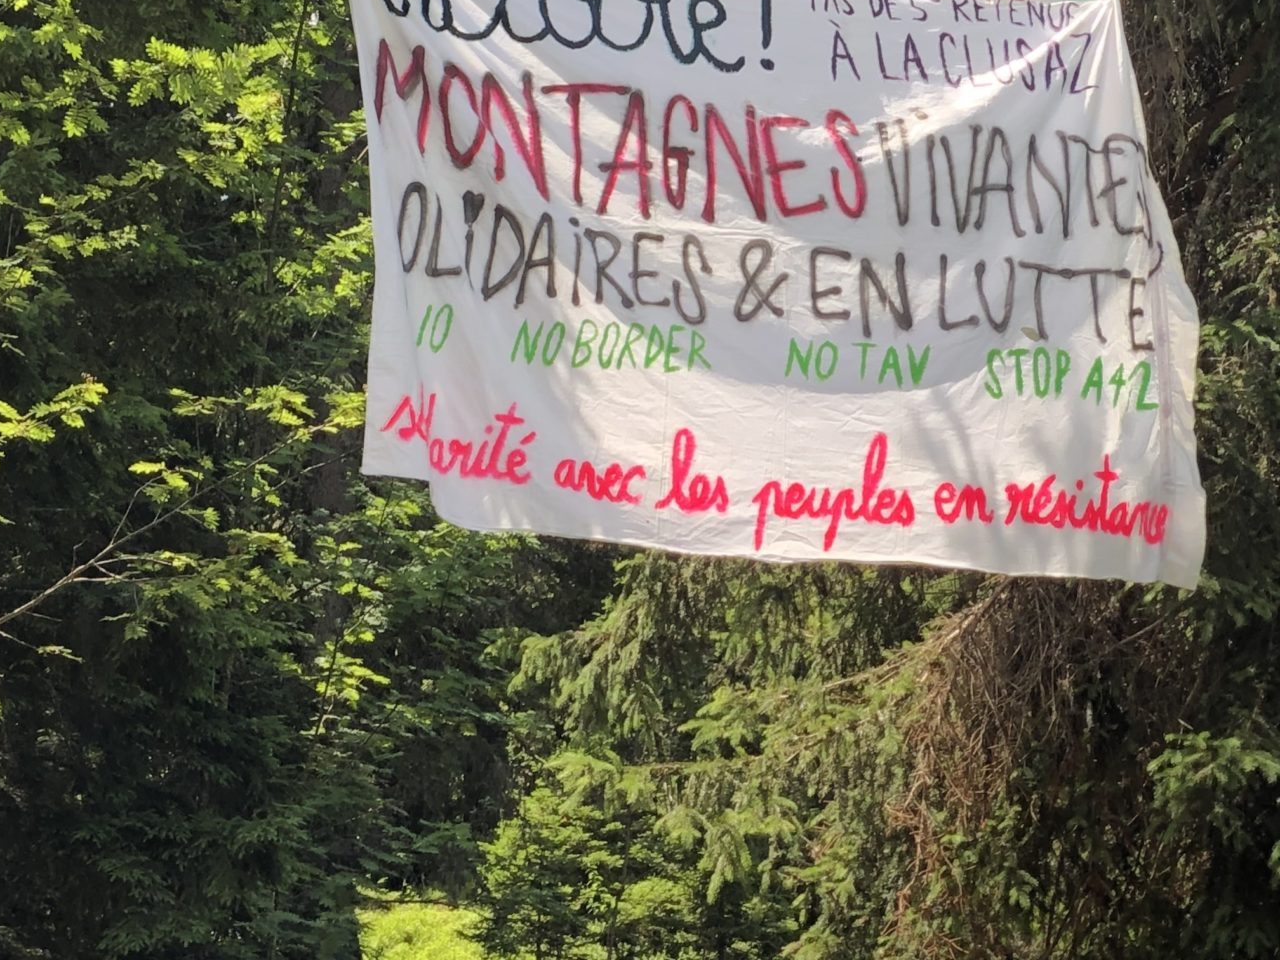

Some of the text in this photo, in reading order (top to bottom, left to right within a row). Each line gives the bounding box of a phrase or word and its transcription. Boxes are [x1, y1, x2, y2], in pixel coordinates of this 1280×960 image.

[829, 19, 1100, 95] À LA CLUSAZ
[373, 38, 868, 224] MONTAGNES
[733, 238, 791, 322] &
[810, 246, 913, 338] EN
[938, 252, 1154, 353] LUTTE
[508, 319, 568, 368] NO
[569, 318, 712, 374] BORDER
[783, 337, 839, 383] NO
[853, 342, 933, 389] TAV
[983, 346, 1072, 401] STOP
[552, 456, 648, 506] avec
[654, 426, 731, 516] les
[752, 431, 917, 553] peuples
[932, 480, 996, 526] en
